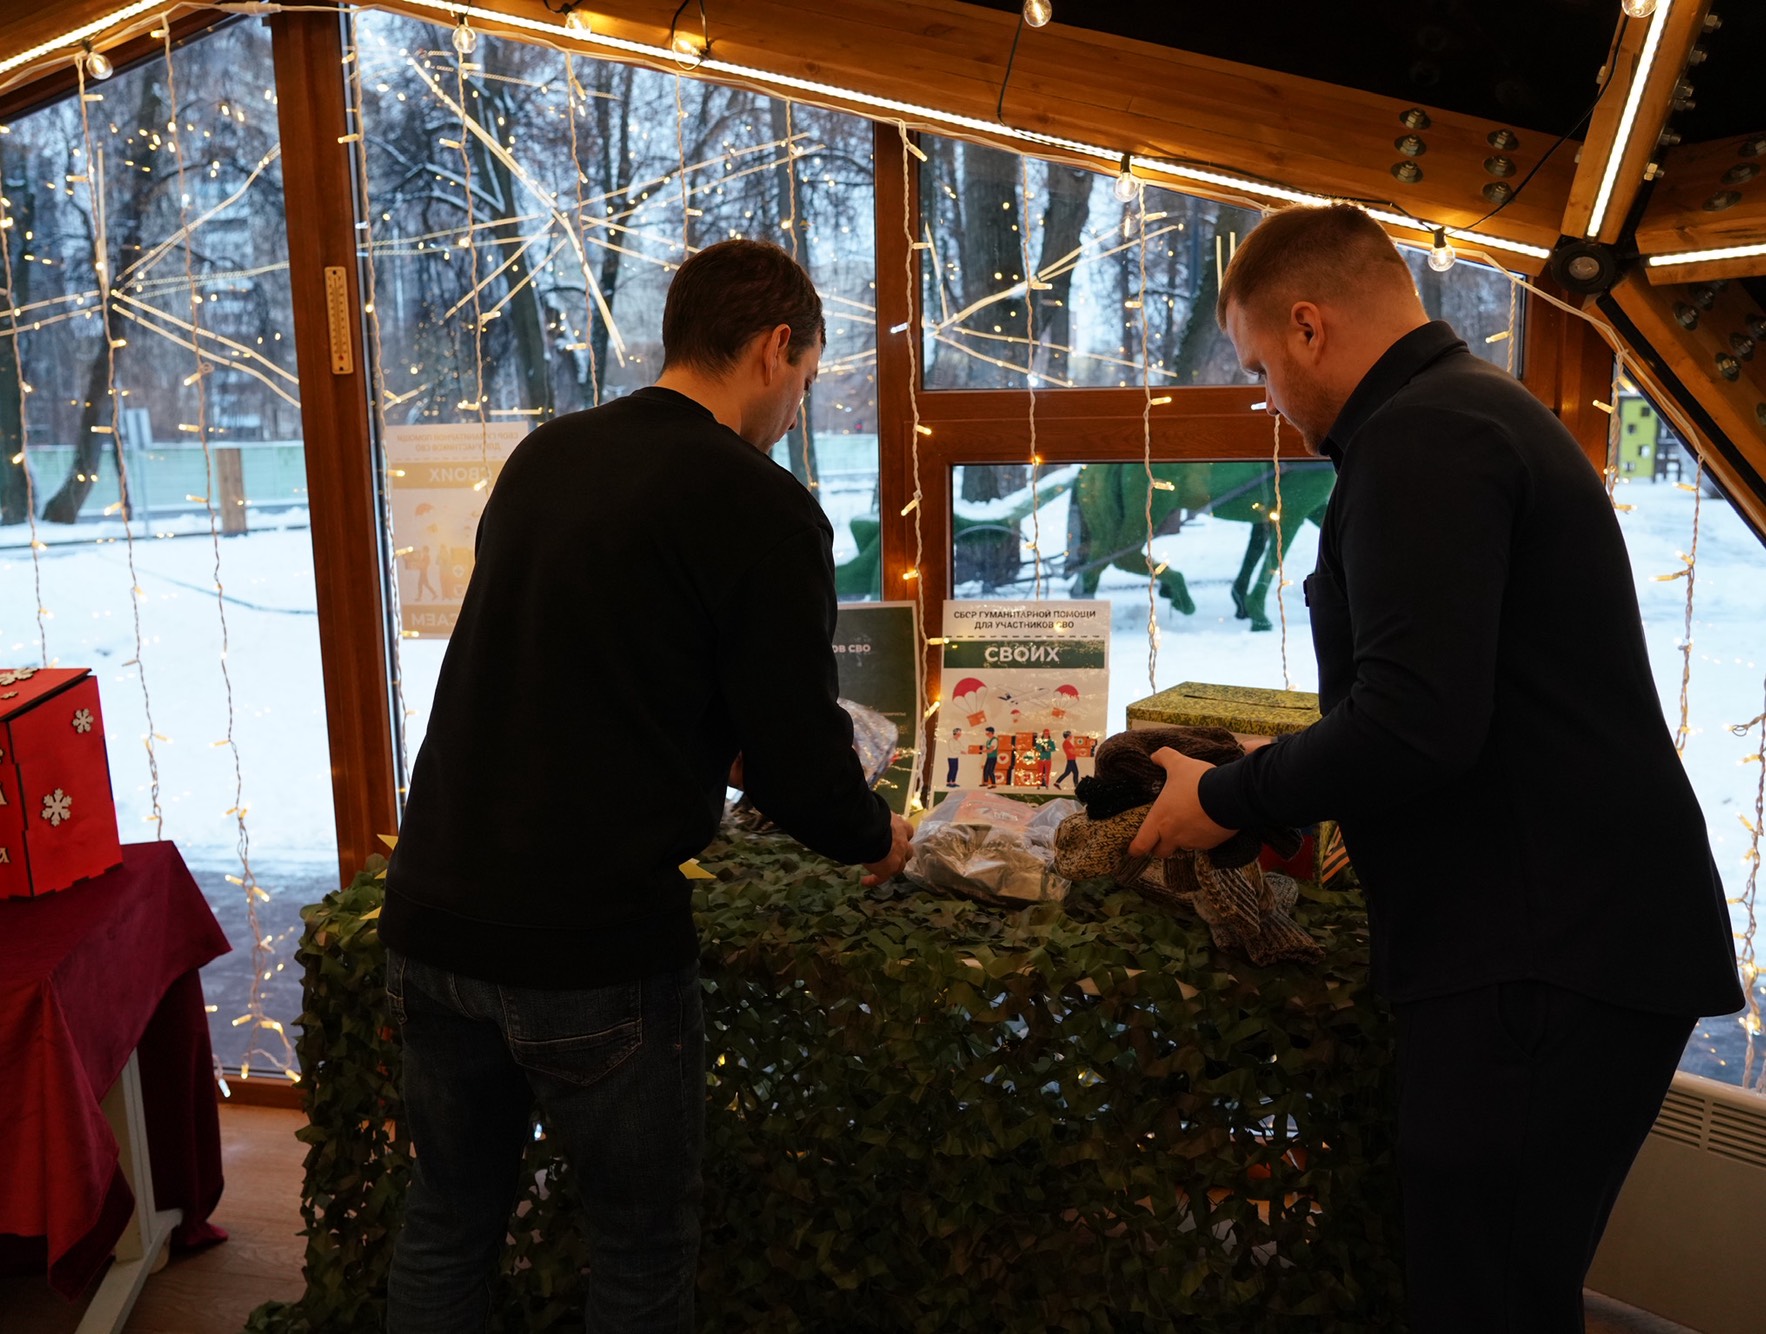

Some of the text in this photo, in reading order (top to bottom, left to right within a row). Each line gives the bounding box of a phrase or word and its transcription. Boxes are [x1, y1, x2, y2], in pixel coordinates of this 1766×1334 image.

[979, 609, 1052, 619] ГУМАНИТАРНОЙ
[1053, 610, 1097, 620] ПОМОЩИ
[974, 621, 993, 630] ДЛЯ
[995, 621, 1054, 629] УЧАСТНИКОВ
[848, 643, 872, 653] СВО
[984, 645, 1061, 663] СВОИХ
